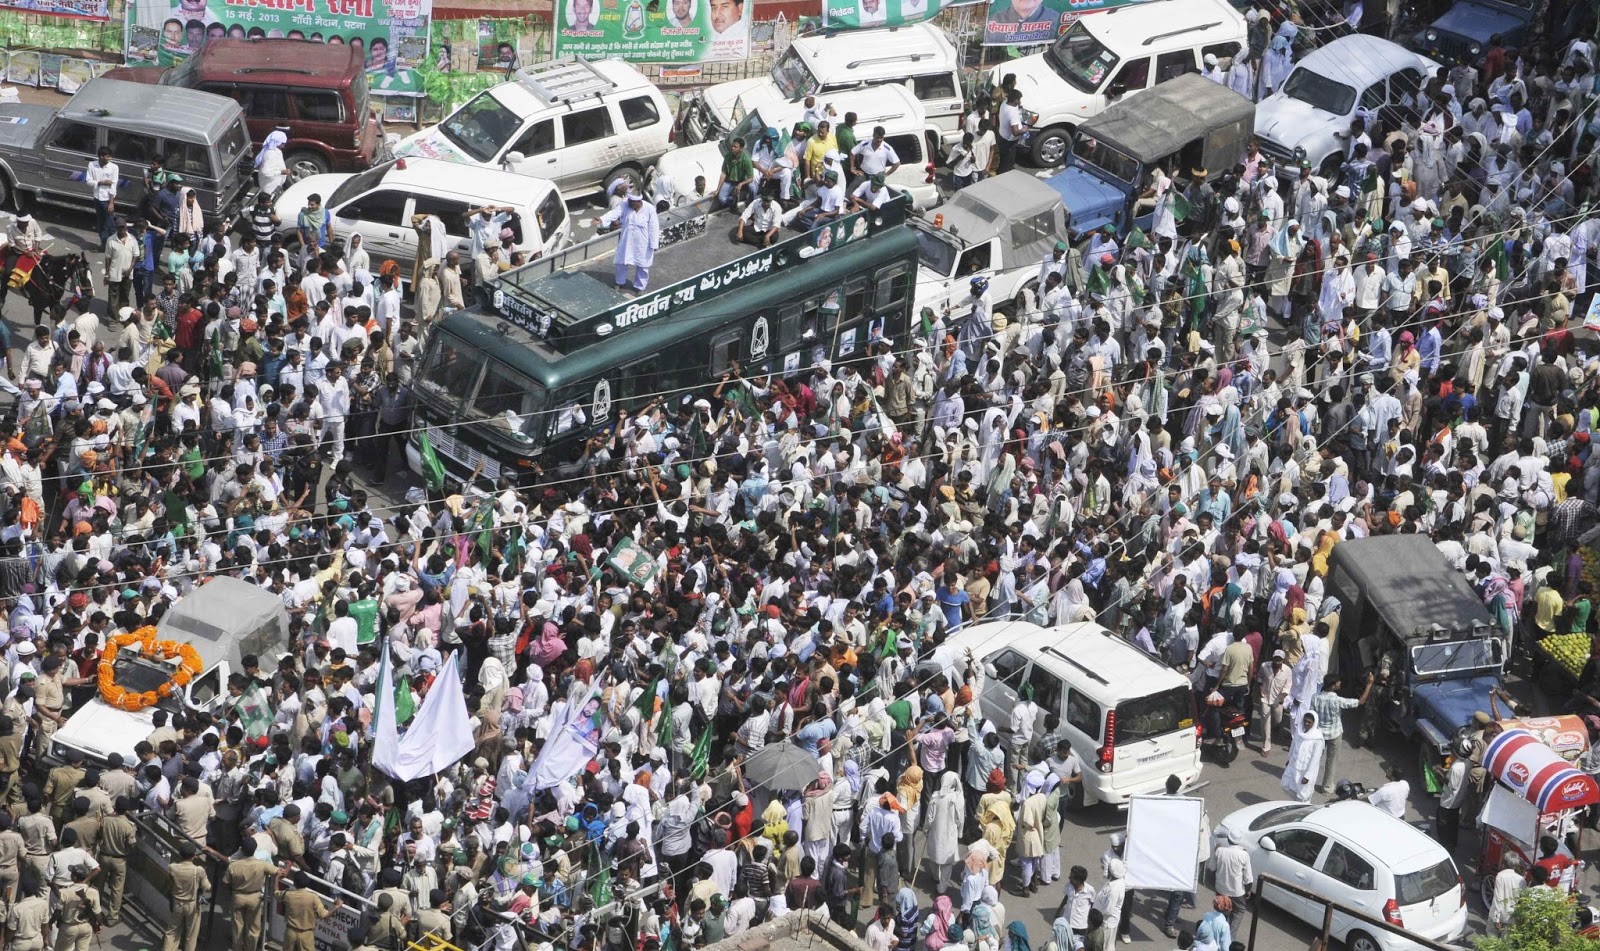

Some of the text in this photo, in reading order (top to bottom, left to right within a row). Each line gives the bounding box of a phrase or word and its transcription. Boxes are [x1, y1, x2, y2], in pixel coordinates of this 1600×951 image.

[225, 10, 235, 19] 15
[258, 14, 280, 23] 2013
[344, 20, 366, 30] पटना
[1021, 21, 1052, 33] अहमद
[615, 294, 672, 329] परिवर्तन
[318, 924, 341, 940] PATNA
